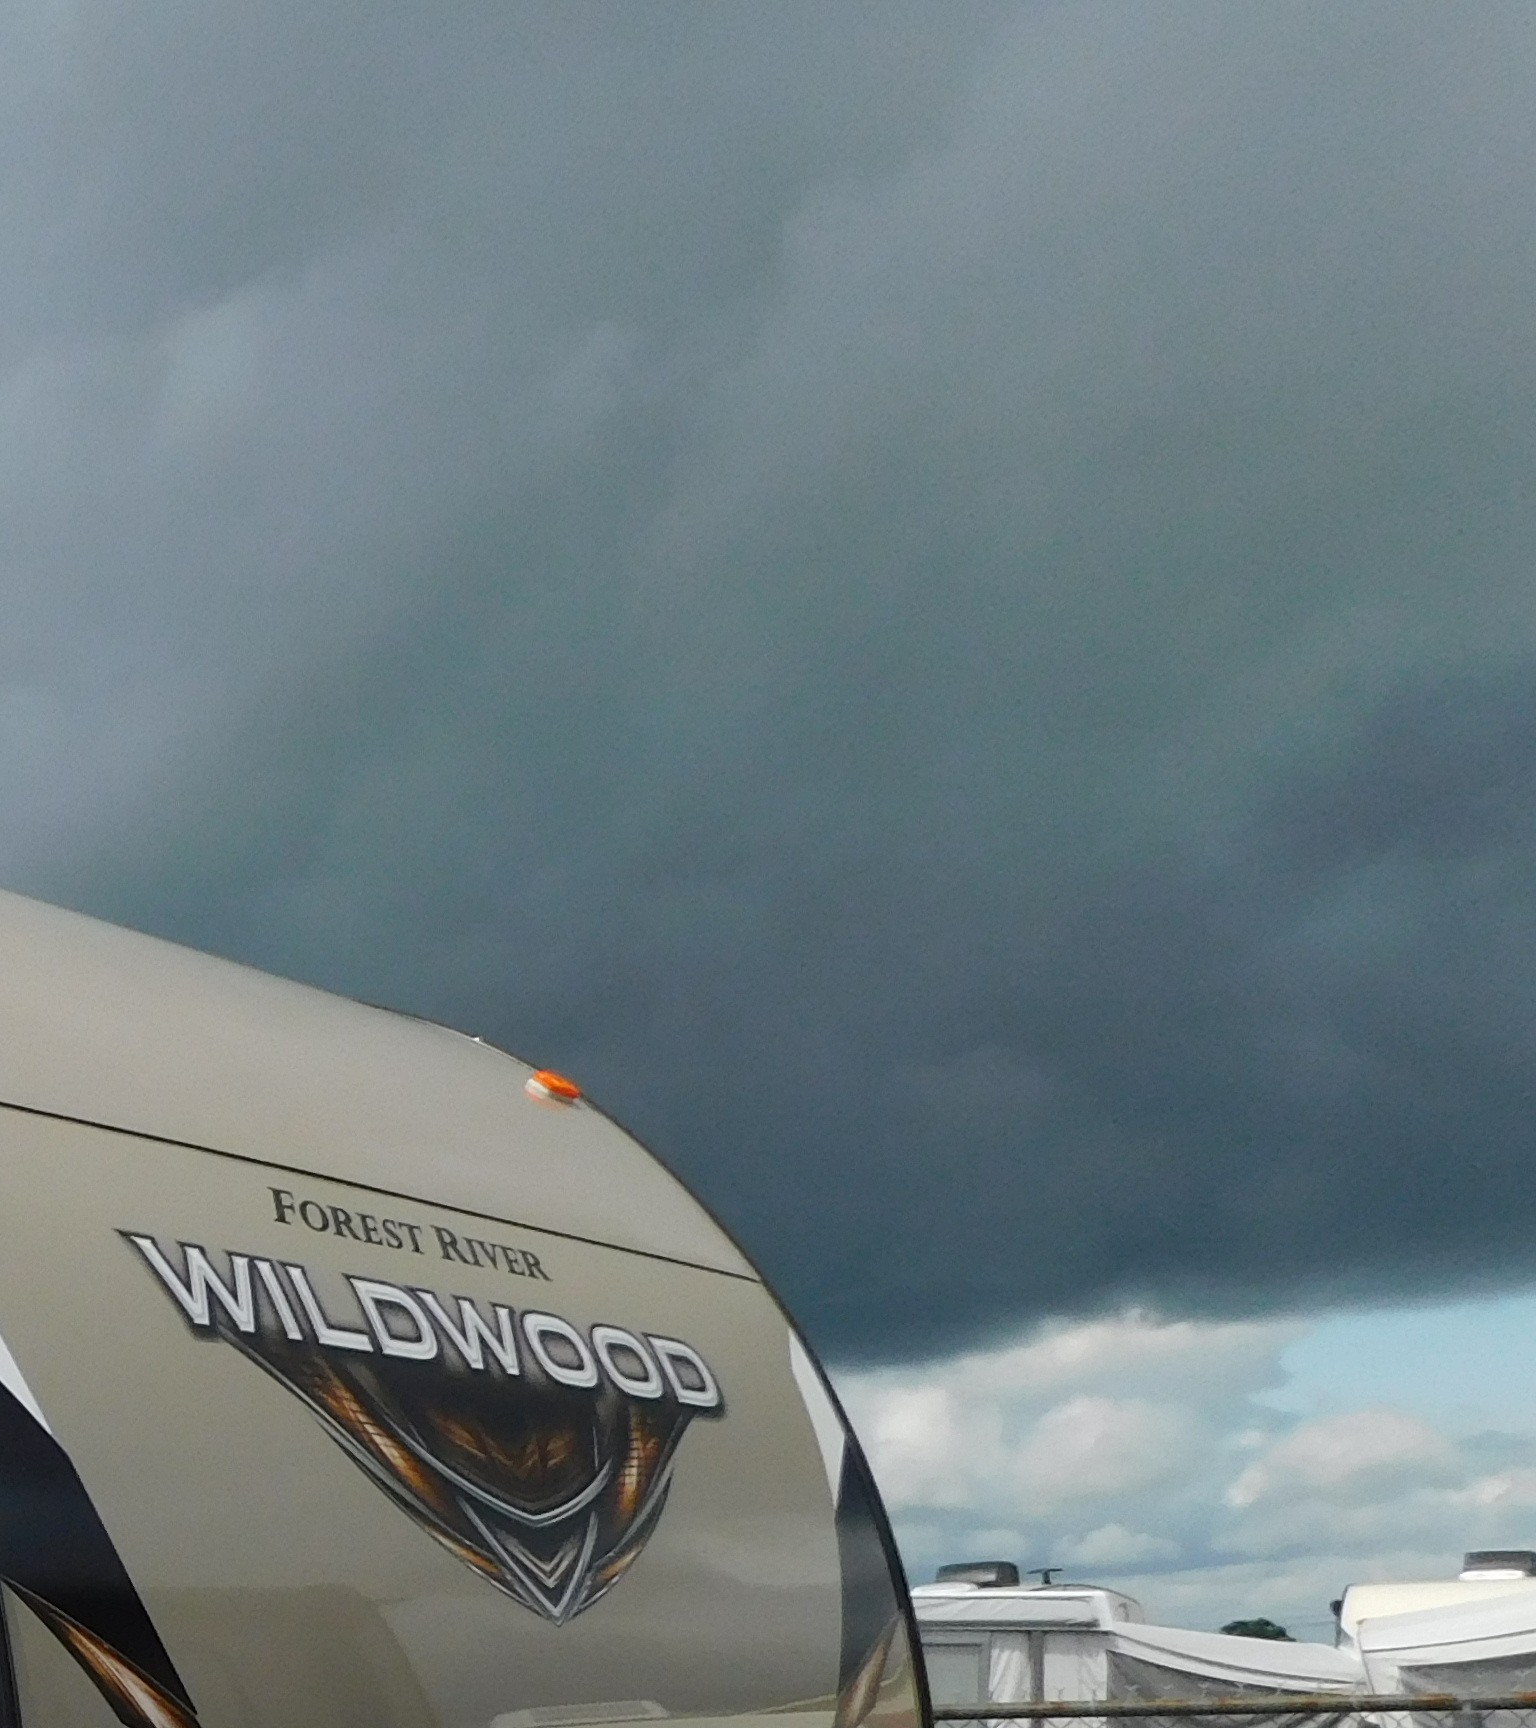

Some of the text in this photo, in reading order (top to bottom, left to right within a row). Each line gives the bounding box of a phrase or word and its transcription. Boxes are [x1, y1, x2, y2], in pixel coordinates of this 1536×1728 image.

[267, 1186, 553, 1282] FOREST RIVER
[115, 1229, 725, 1408] WILDWOOD
